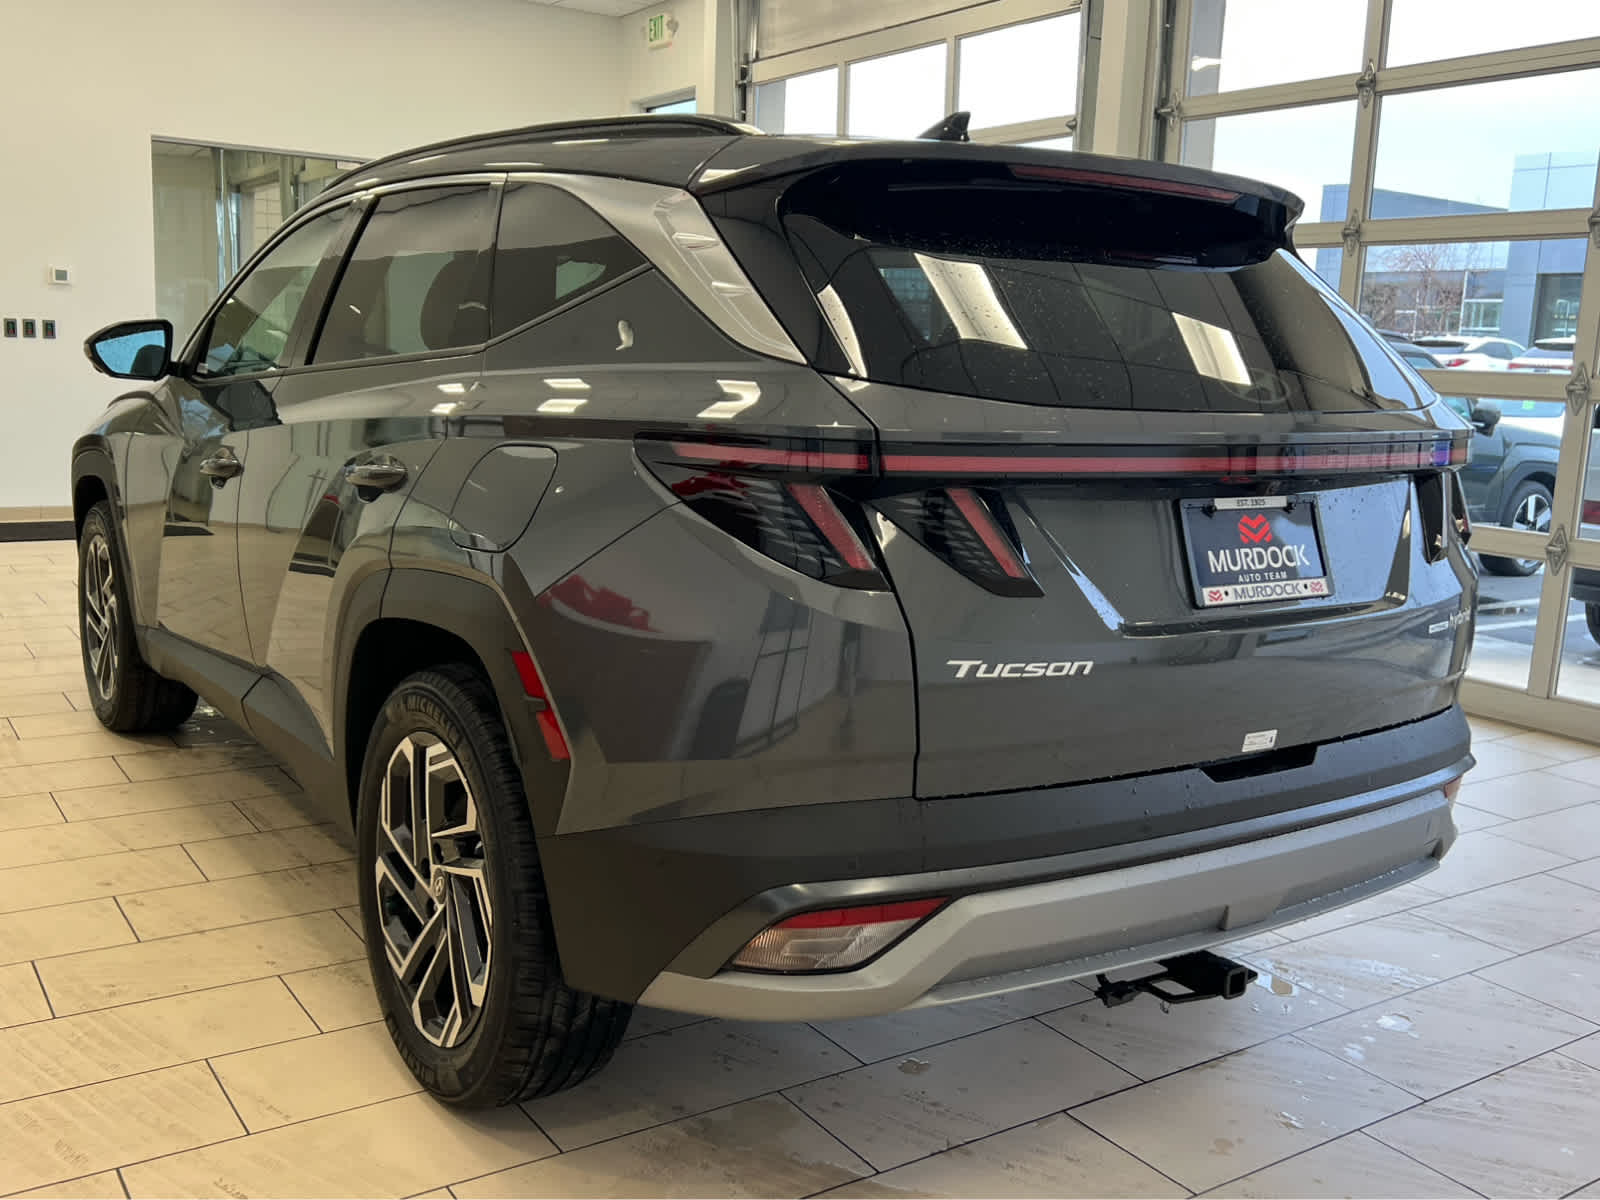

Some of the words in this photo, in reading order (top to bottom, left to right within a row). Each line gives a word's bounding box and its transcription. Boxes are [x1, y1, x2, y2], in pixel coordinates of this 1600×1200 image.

[649, 15, 665, 42] EXIT
[1207, 544, 1310, 573] MURDOCK
[1238, 571, 1261, 583] AUTO
[1263, 570, 1288, 580] TEAM
[1233, 582, 1301, 600] MURDOCK
